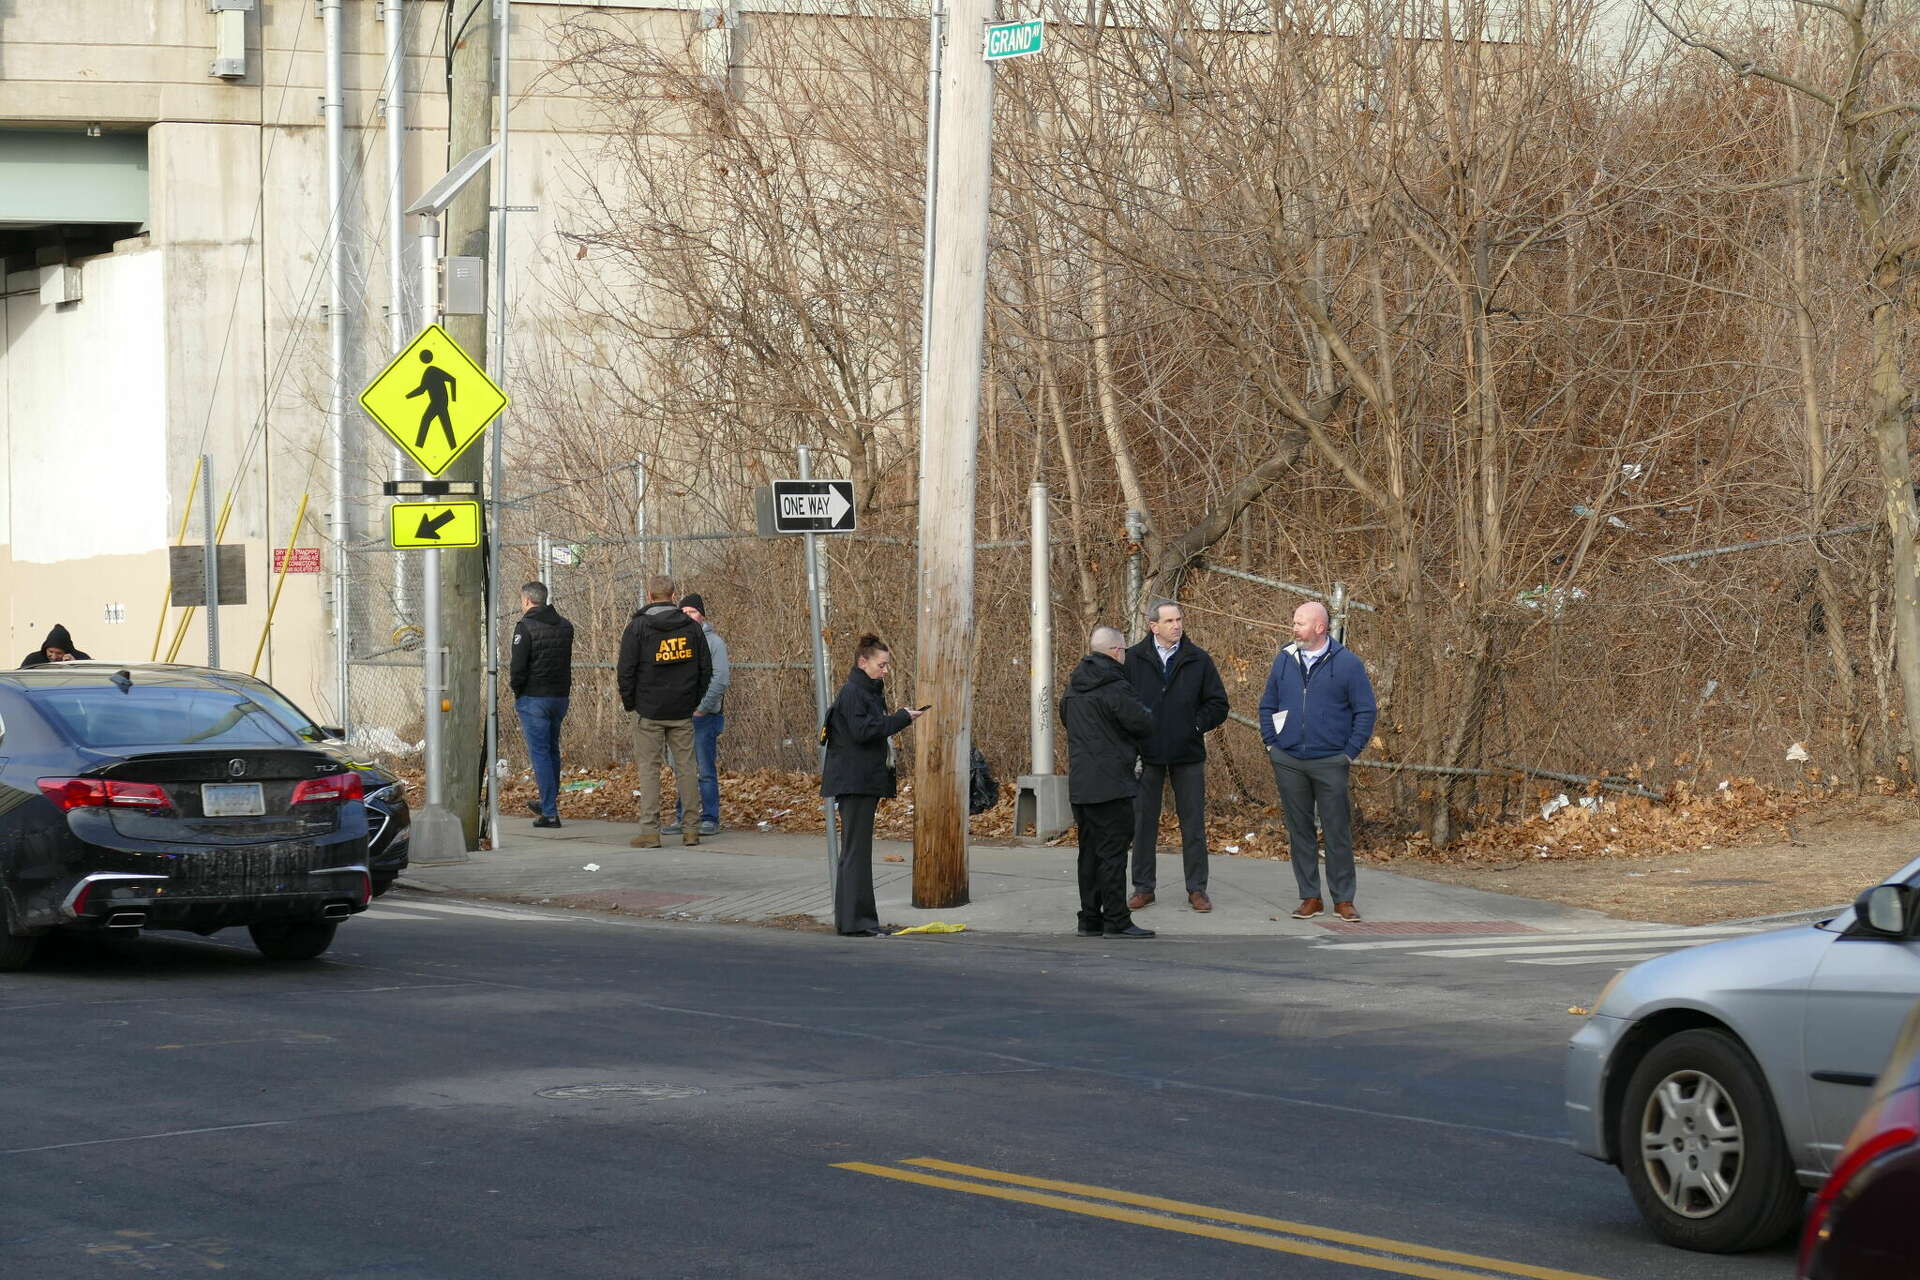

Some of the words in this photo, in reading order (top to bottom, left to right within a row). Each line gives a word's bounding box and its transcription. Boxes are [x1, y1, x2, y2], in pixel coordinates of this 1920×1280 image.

[991, 26, 1031, 54] GRAND
[1032, 23, 1041, 39] AV
[784, 496, 805, 516] ONE
[808, 496, 830, 516] WAY
[659, 637, 687, 652] ATF
[655, 648, 693, 662] POLICE
